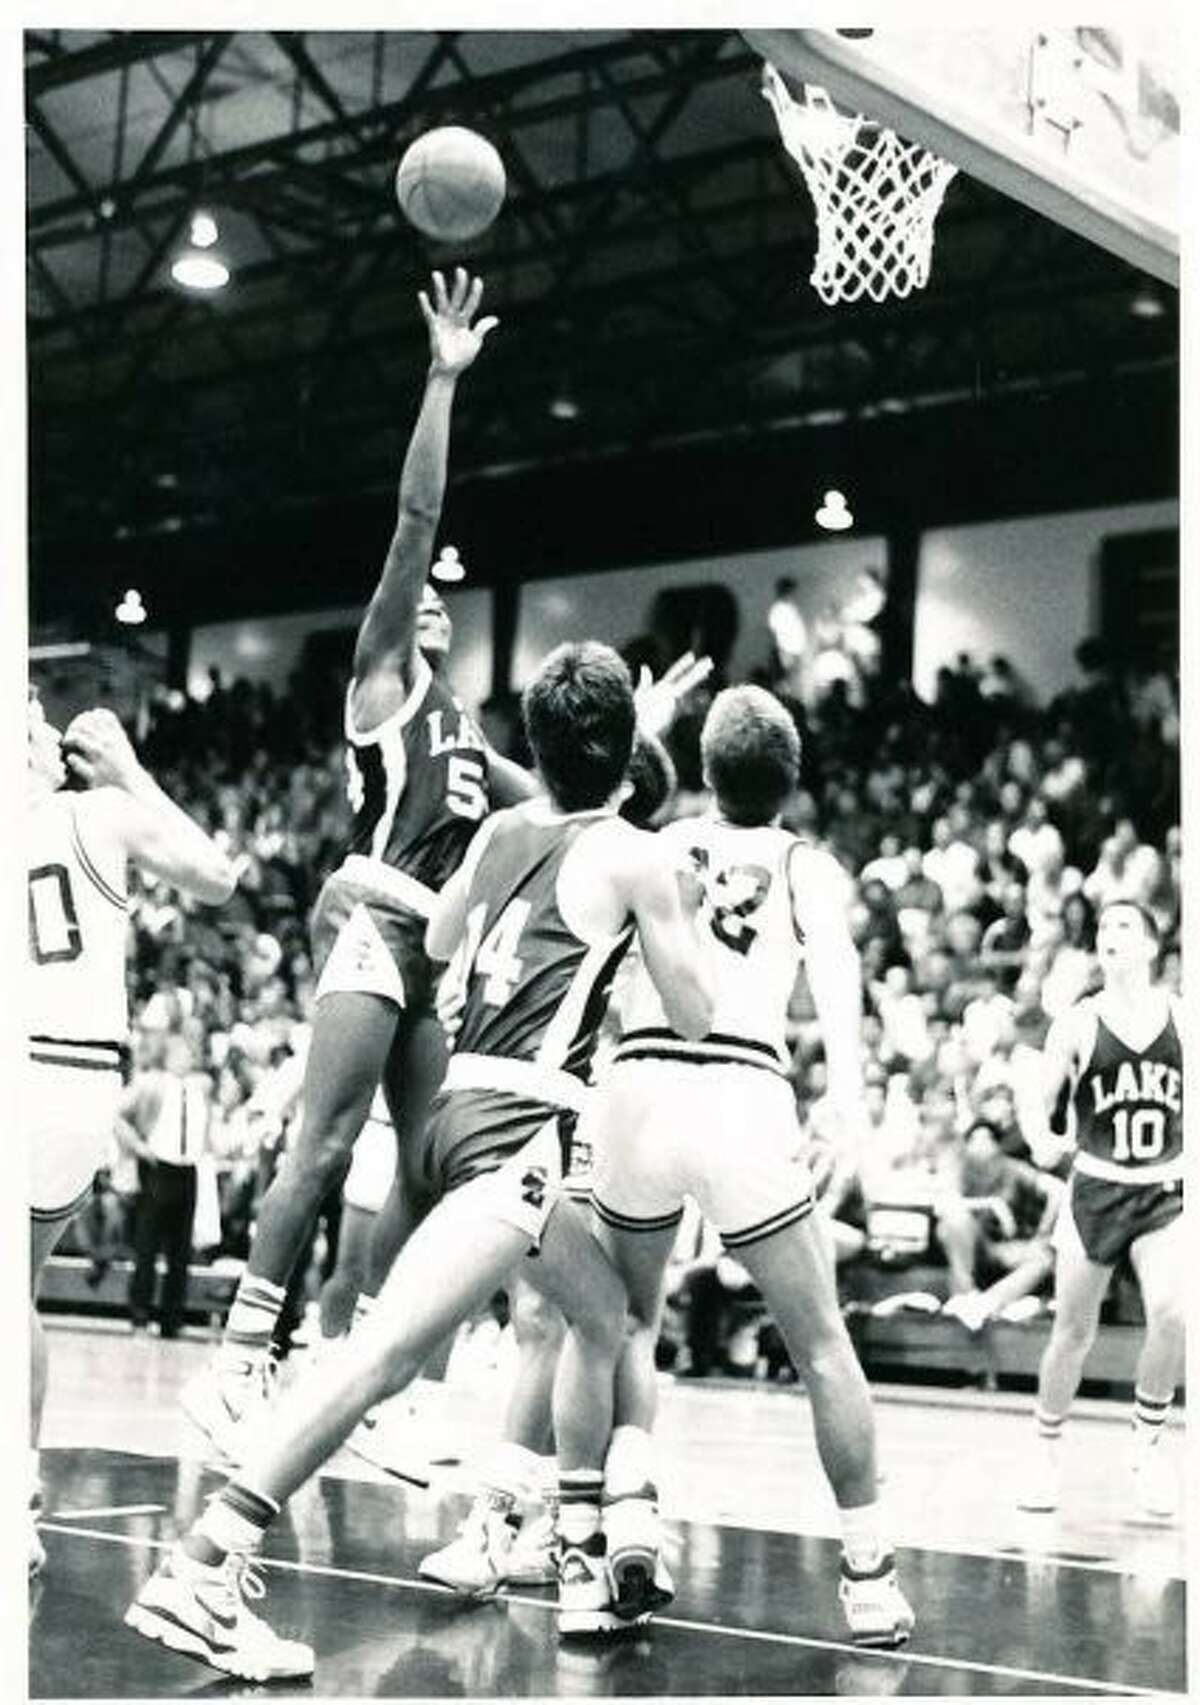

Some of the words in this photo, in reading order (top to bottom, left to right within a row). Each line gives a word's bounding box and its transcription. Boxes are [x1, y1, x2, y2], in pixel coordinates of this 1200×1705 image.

[446, 756, 491, 821] 5
[465, 897, 532, 1006] 14
[1091, 1060, 1180, 1115] LAKE
[1113, 1109, 1165, 1161] 10
